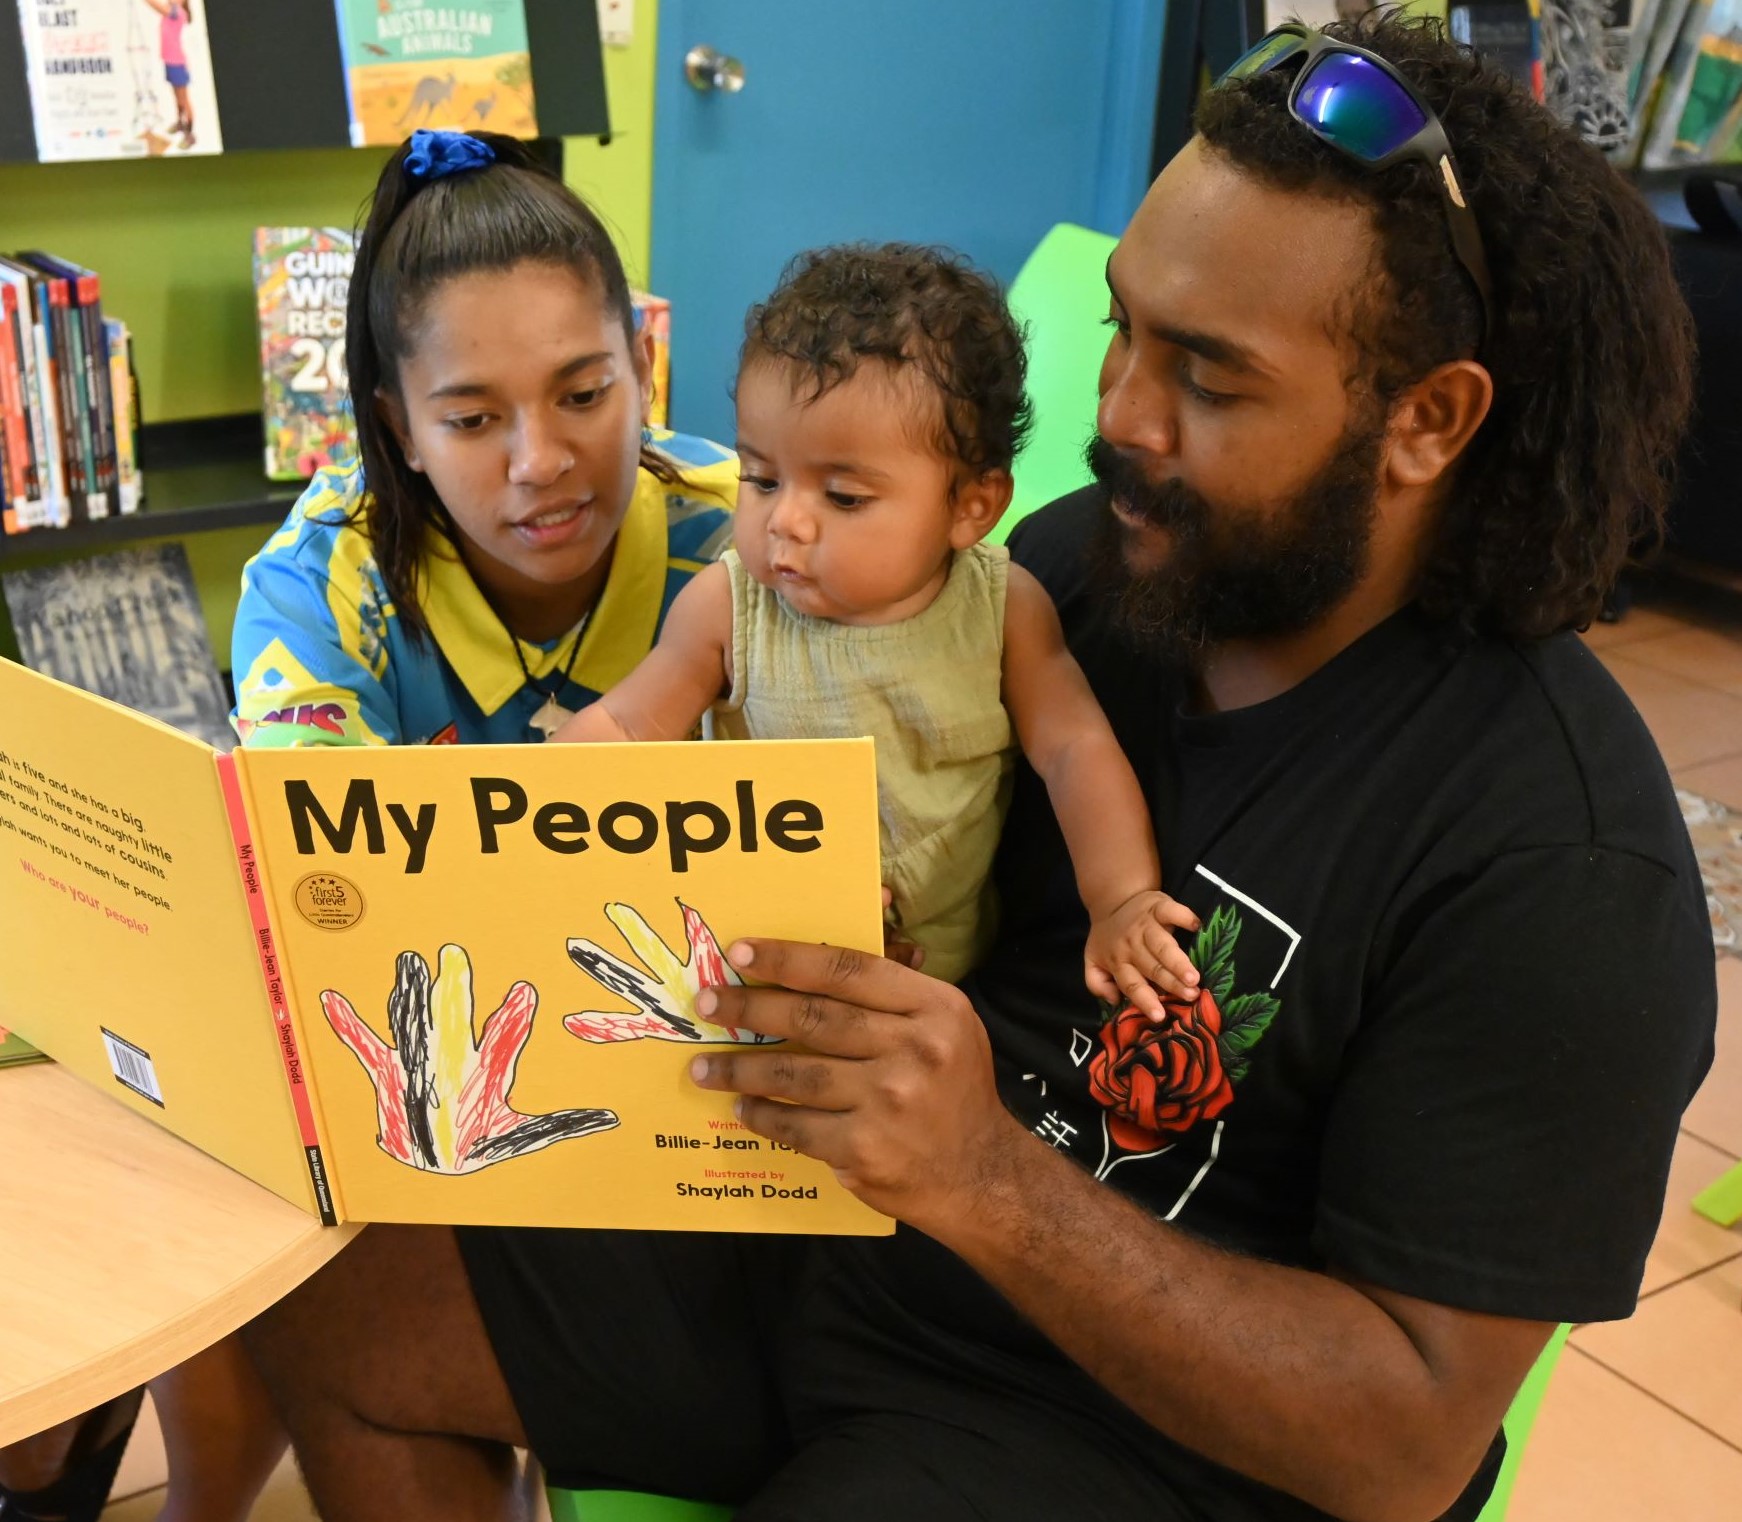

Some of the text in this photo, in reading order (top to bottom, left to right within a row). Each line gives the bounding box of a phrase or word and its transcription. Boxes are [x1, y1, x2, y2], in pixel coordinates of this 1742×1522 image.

[377, 8, 493, 39] AUSTRALIAN
[402, 33, 473, 55] ANIMALS
[285, 251, 355, 276] GUIN
[287, 310, 346, 337] REC
[290, 338, 349, 392] 20
[13, 759, 20, 771] is
[23, 761, 45, 783] five
[48, 778, 68, 794] and
[71, 788, 88, 803] she
[90, 796, 108, 813] has
[112, 808, 119, 818] a
[19, 801, 38, 816] and
[40, 808, 58, 827] lots
[61, 822, 81, 838] and
[82, 830, 102, 848] lots
[105, 843, 116, 855] of
[43, 791, 73, 815] There
[75, 811, 93, 825] are
[95, 820, 139, 849] naughty
[141, 837, 173, 864] little
[283, 777, 824, 873] My People
[19, 827, 47, 848] wants
[50, 843, 67, 858] you
[70, 852, 82, 865] to
[84, 860, 110, 880] meet
[113, 872, 130, 890] her
[240, 844, 257, 894] My People
[20, 858, 149, 935] Who are your people?
[312, 894, 347, 906] forever
[259, 928, 283, 1005] Billie-Jean Taylor
[280, 1024, 303, 1085] Shaylah Dodd
[709, 1120, 749, 1130] Writte
[310, 1149, 318, 1162] State
[655, 1134, 760, 1151] Billie-Jean
[313, 1162, 322, 1180] Library
[704, 1169, 784, 1181] Illustrated by
[676, 1182, 818, 1200] Shaylah Dodd
